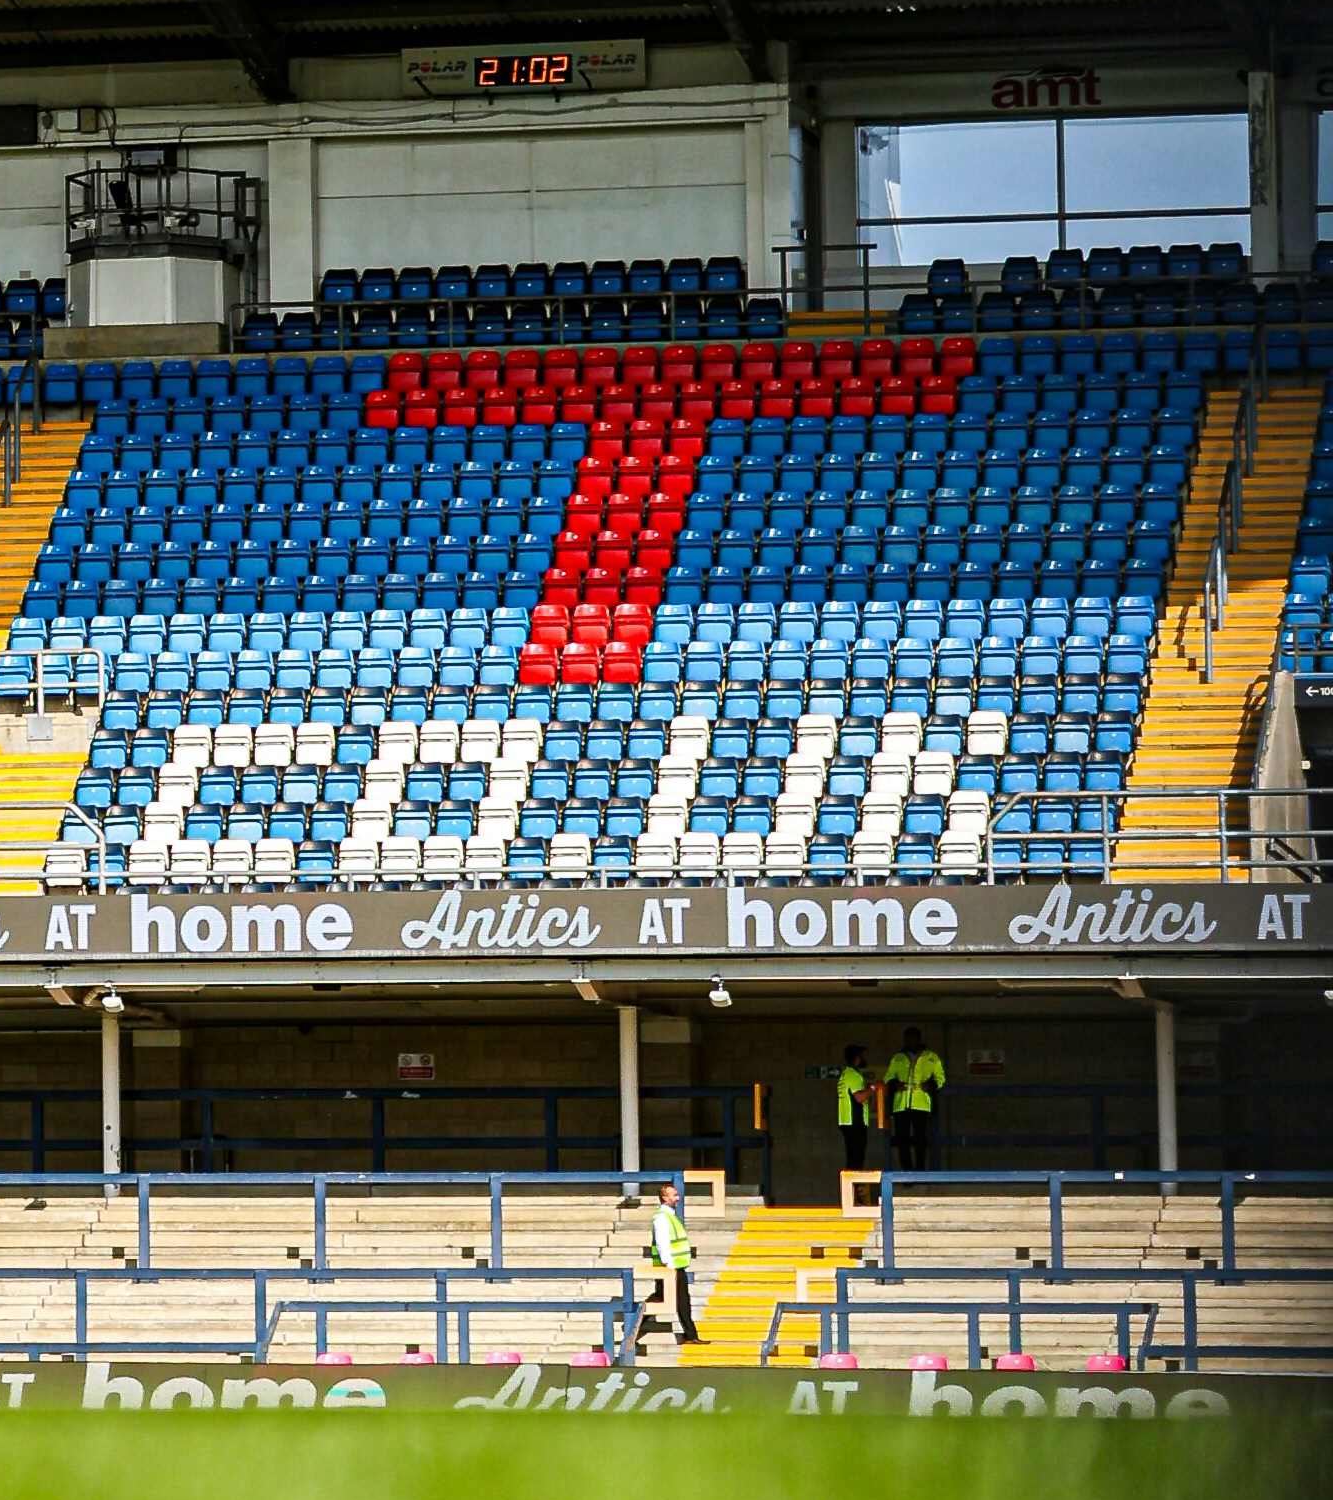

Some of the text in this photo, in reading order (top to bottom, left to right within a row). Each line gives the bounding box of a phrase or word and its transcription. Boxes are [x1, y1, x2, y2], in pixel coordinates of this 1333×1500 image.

[407, 60, 467, 74] POLAR
[479, 56, 568, 85] 21:02
[577, 53, 637, 67] POLAR
[991, 67, 1101, 110] amt
[44, 904, 96, 951] AT
[131, 894, 354, 953] home
[400, 889, 601, 951] Antics
[638, 898, 691, 945] AT
[727, 887, 959, 948] home
[1008, 884, 1216, 945] Antics
[1256, 894, 1310, 941] AT
[787, 1380, 859, 1415] AT
